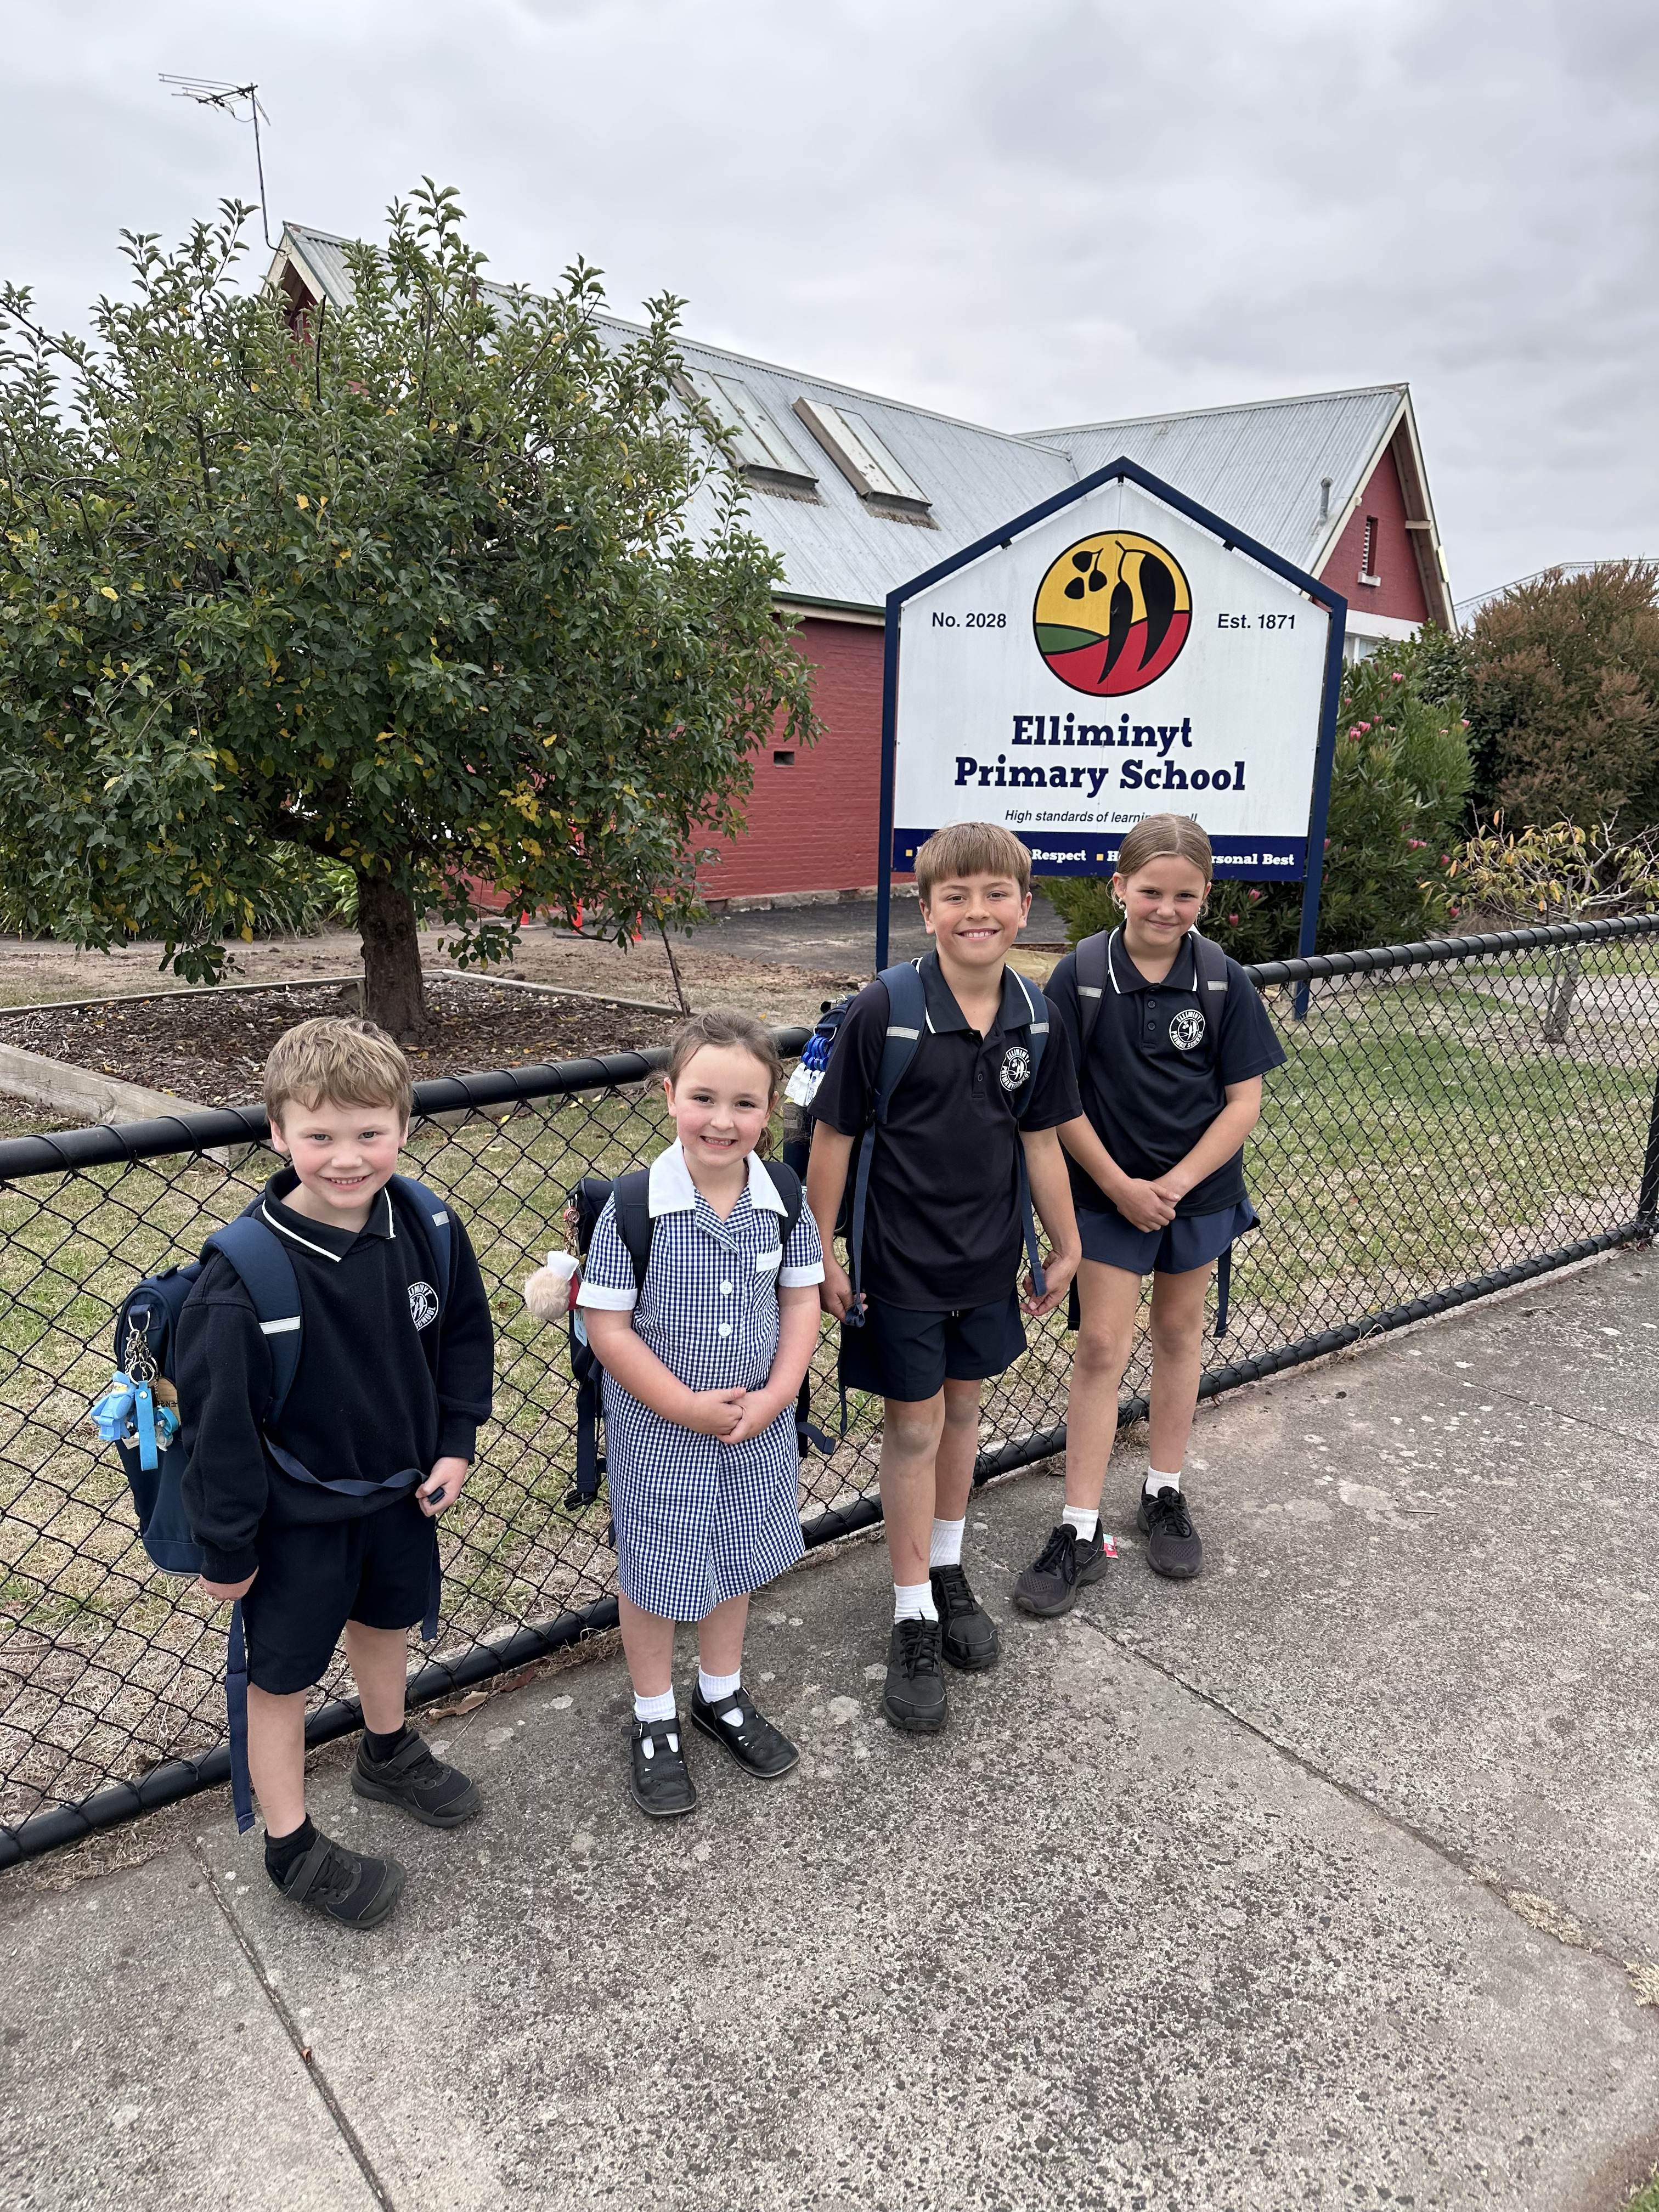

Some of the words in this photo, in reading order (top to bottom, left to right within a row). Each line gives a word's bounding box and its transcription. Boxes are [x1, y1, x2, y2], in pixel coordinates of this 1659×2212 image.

[932, 612, 960, 628] No.
[966, 613, 1007, 628] 2028
[1217, 613, 1251, 629] Est.
[1258, 614, 1295, 629] 1871
[1011, 712, 1193, 757] Elliminyt
[954, 753, 1109, 798] Primary
[1119, 759, 1246, 791] School
[1005, 810, 1032, 823] High
[1035, 811, 1094, 822] standards
[1096, 811, 1109, 822] of
[1111, 812, 1151, 823] learni
[1032, 849, 1086, 864] Respect
[1211, 853, 1258, 865] rsonal
[1262, 854, 1295, 866] Best
[408, 1284, 432, 1297] LIMINYT
